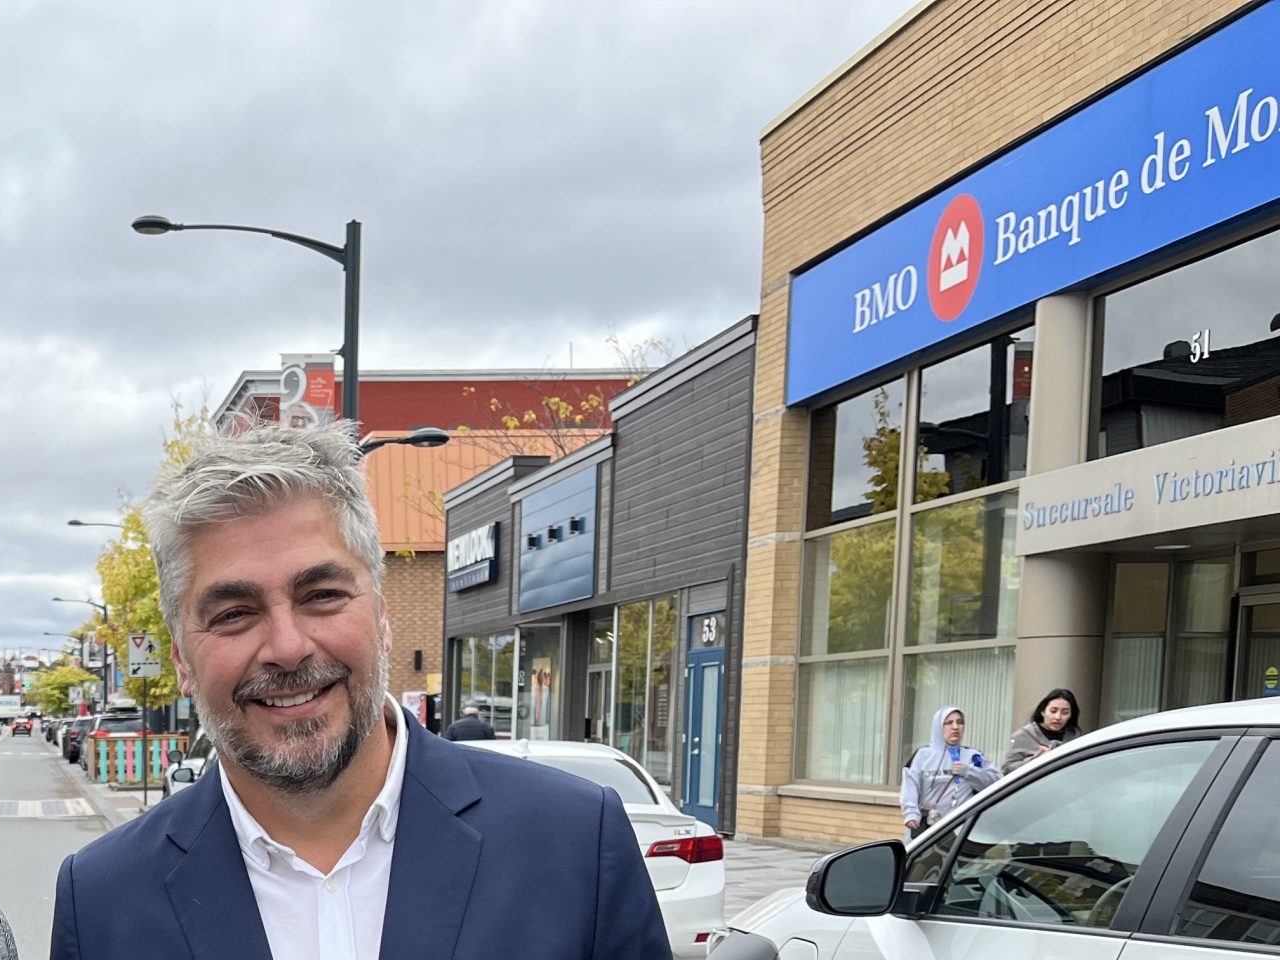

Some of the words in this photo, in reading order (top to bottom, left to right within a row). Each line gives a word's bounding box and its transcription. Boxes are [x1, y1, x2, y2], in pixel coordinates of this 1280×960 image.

[852, 264, 918, 334] BMO
[993, 169, 1129, 266] Banque
[1140, 131, 1191, 195] de
[1201, 87, 1280, 168] Mo
[1189, 328, 1210, 364] 51
[1023, 482, 1135, 531] Succursale
[702, 616, 717, 643] 53
